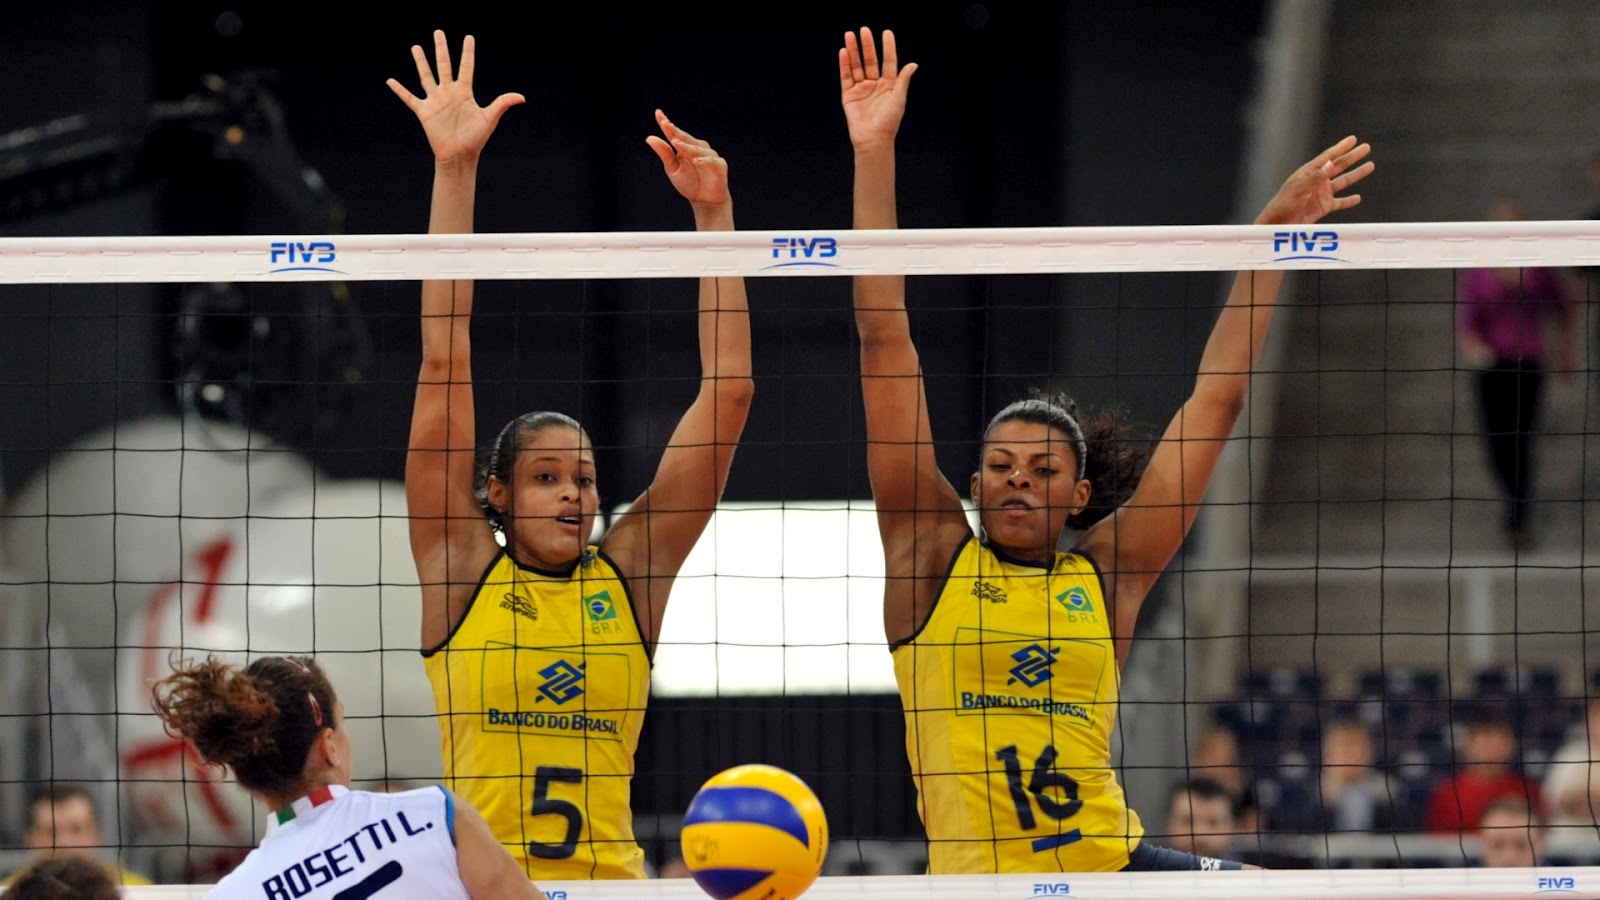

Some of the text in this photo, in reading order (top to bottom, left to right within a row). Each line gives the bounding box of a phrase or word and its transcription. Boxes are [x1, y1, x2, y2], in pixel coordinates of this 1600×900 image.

[773, 237, 837, 258] FIVB
[1274, 231, 1339, 252] FIVB
[271, 242, 336, 263] FIVB
[591, 621, 622, 635] BRA
[1068, 612, 1100, 625] BRA
[961, 692, 1090, 721] BANCO DO BRASIL
[488, 708, 619, 735] BANCO DO BRASIL
[995, 744, 1084, 830] 16
[529, 764, 583, 860] 5
[262, 818, 397, 900] ROSETTI
[396, 811, 433, 836] L.
[1033, 883, 1070, 895] FIVB
[1537, 877, 1574, 889] FIVB
[542, 891, 568, 900] VB
